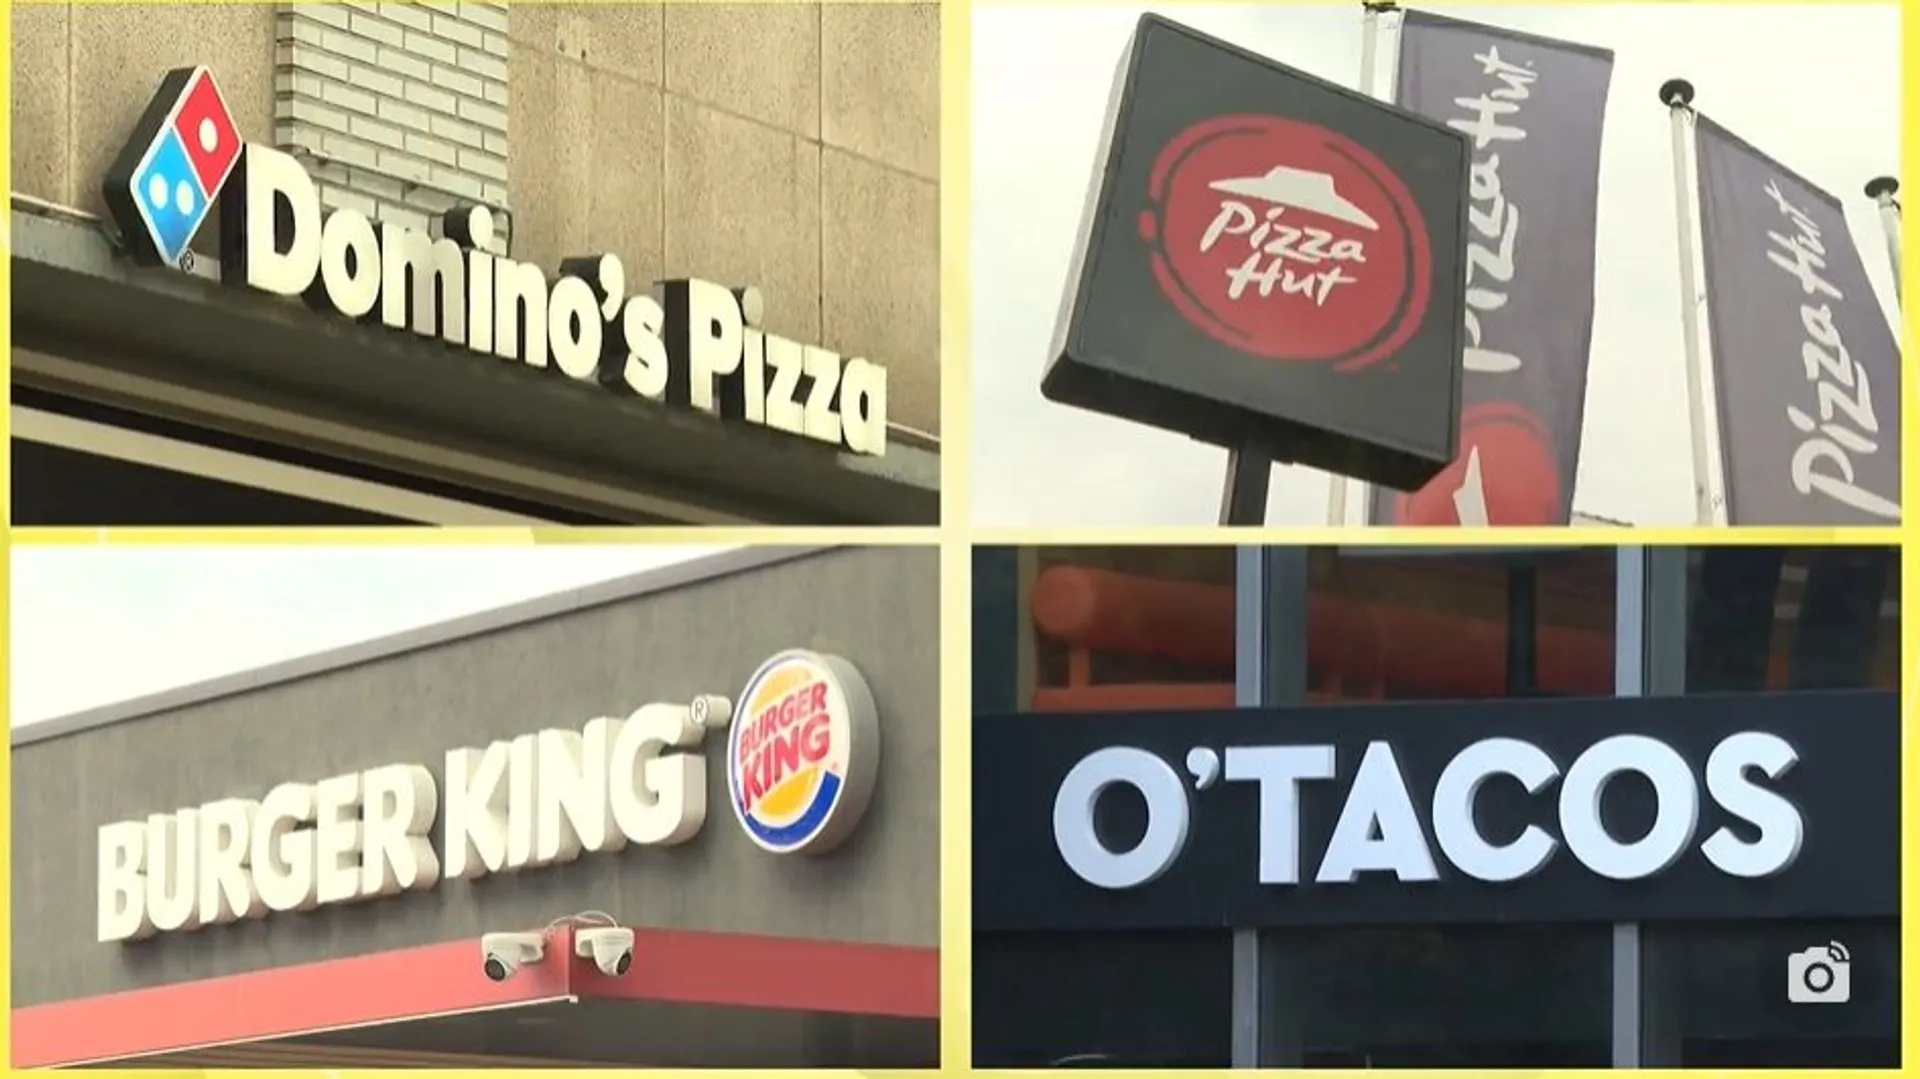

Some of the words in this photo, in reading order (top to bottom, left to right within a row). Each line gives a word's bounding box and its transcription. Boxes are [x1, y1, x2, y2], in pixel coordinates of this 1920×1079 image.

[1446, 45, 1539, 149] Hut
[1200, 200, 1367, 264] Pizza
[1225, 251, 1357, 307] Hut
[1764, 179, 1843, 300] Hut
[246, 143, 668, 400] Domino's
[688, 278, 887, 456] Pizza
[1787, 303, 1901, 518] Pizza
[740, 681, 828, 765] BURGER
[742, 713, 831, 813] KING
[98, 763, 439, 943] BURGER
[445, 701, 705, 879] KING
[1053, 731, 1804, 890] O'TACOS
